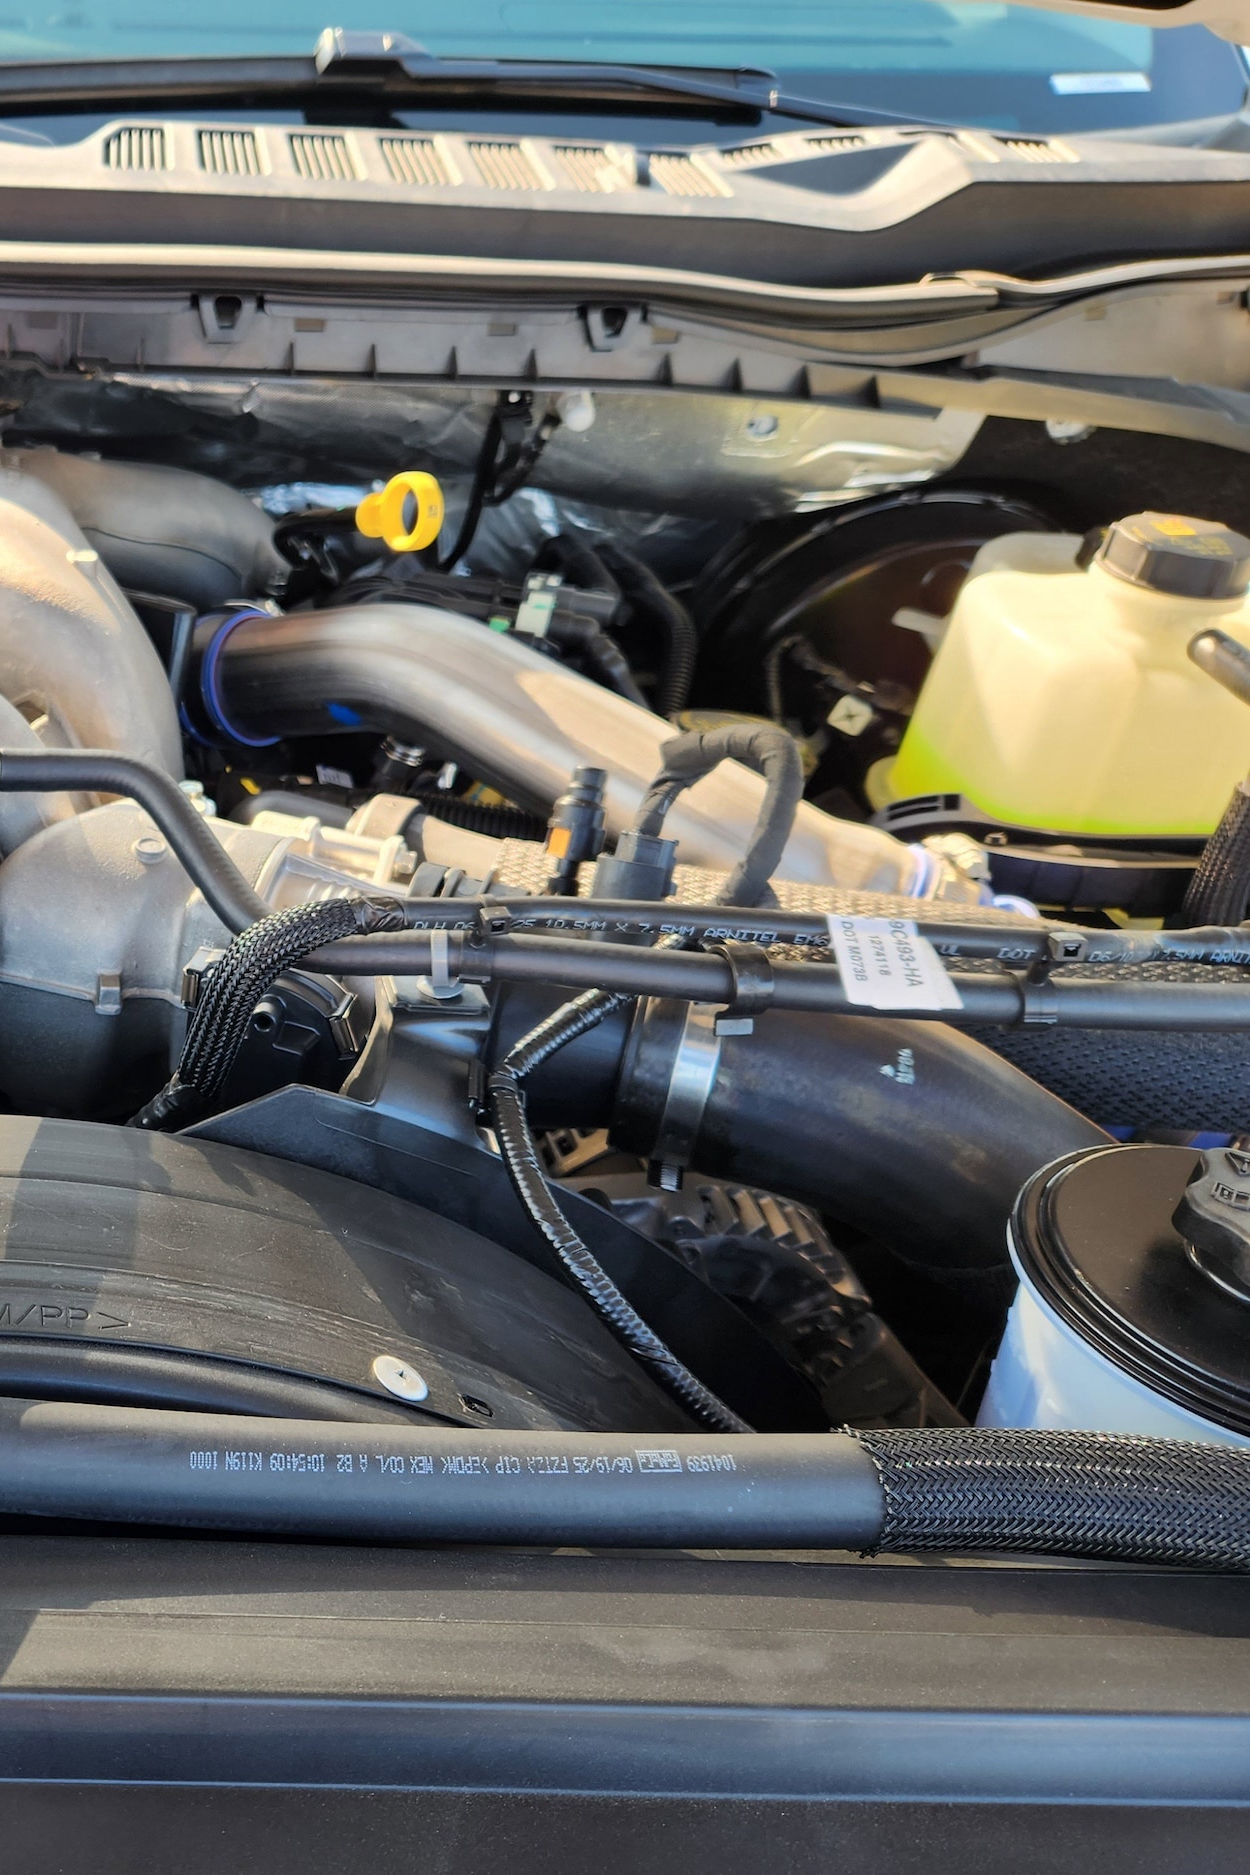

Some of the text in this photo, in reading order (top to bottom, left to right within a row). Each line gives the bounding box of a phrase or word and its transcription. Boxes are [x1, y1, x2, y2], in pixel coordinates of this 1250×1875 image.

[638, 922, 696, 937] 7.5MM
[703, 926, 782, 944] ARNITEL
[840, 920, 859, 945] DOT
[868, 934, 892, 977] 1274118
[996, 947, 1036, 961] DOT
[189, 1450, 219, 1470] 1000
[224, 1450, 263, 1472] K119N
[268, 1451, 326, 1473] 10:54:09
[335, 1453, 353, 1473] B2
[358, 1453, 368, 1473] A
[409, 1455, 434, 1475] MEX
[495, 1454, 521, 1474] CIP
[572, 1455, 634, 1474] 06/19/25
[685, 1453, 738, 1473] 1041939
